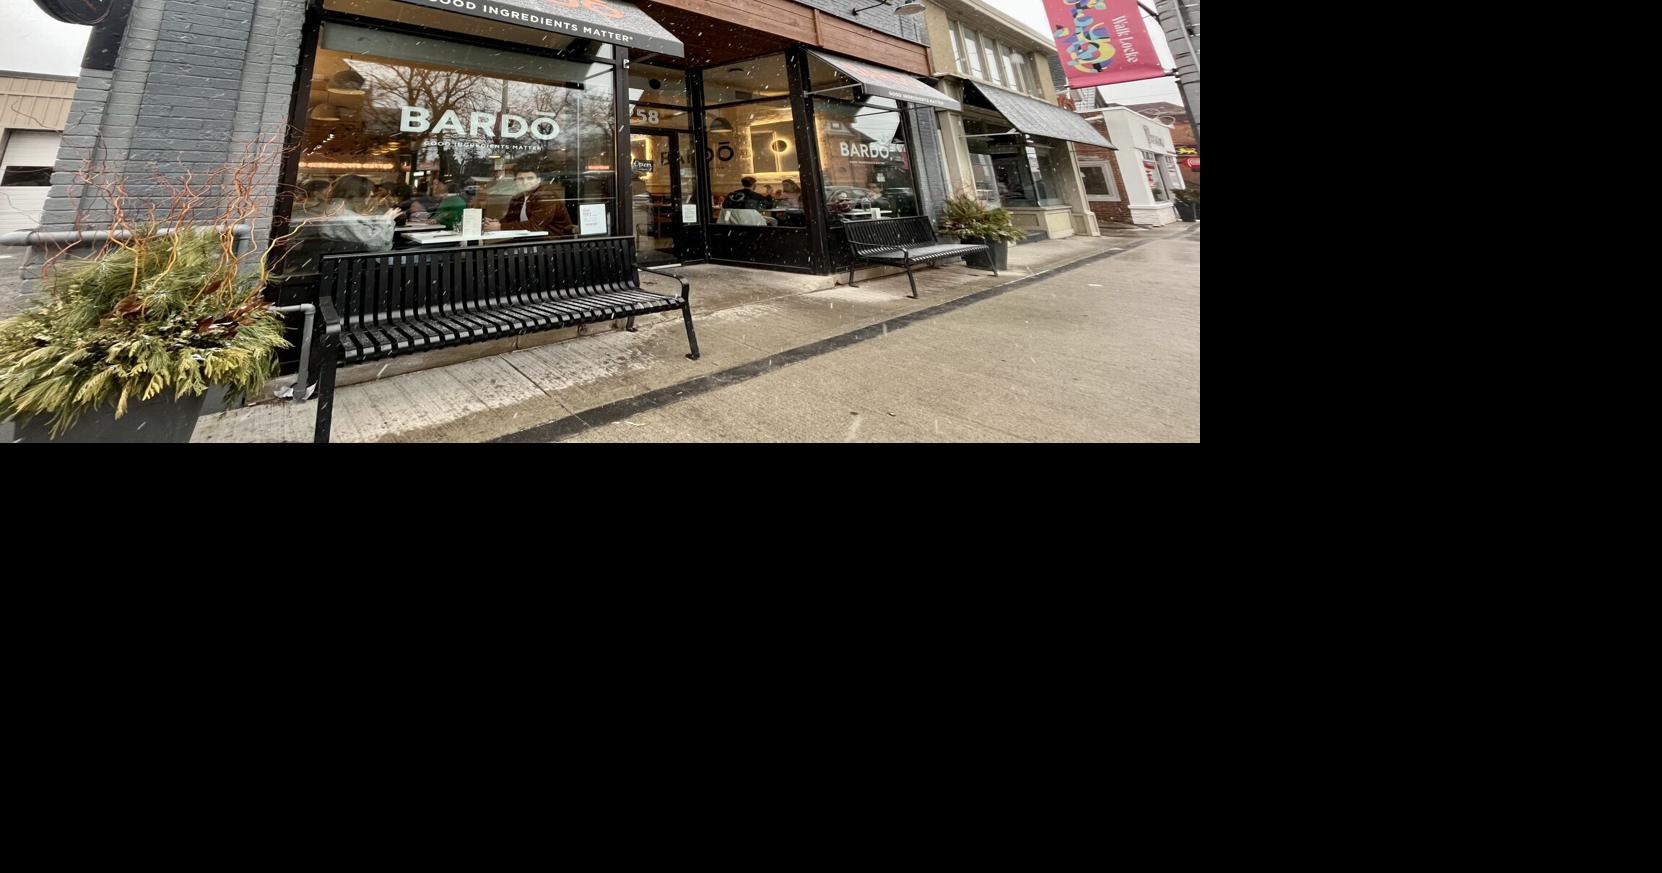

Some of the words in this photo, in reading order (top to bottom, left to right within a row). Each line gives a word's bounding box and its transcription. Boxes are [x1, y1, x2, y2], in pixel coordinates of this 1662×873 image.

[428, 0, 477, 10] OOD
[483, 5, 578, 32] INGREDIENTS
[583, 26, 629, 42] MATTER
[1112, 15, 1130, 37] Walk
[1119, 36, 1139, 63] Locke
[400, 105, 561, 141] BARDŌ
[454, 142, 510, 150] INGREDIENTS
